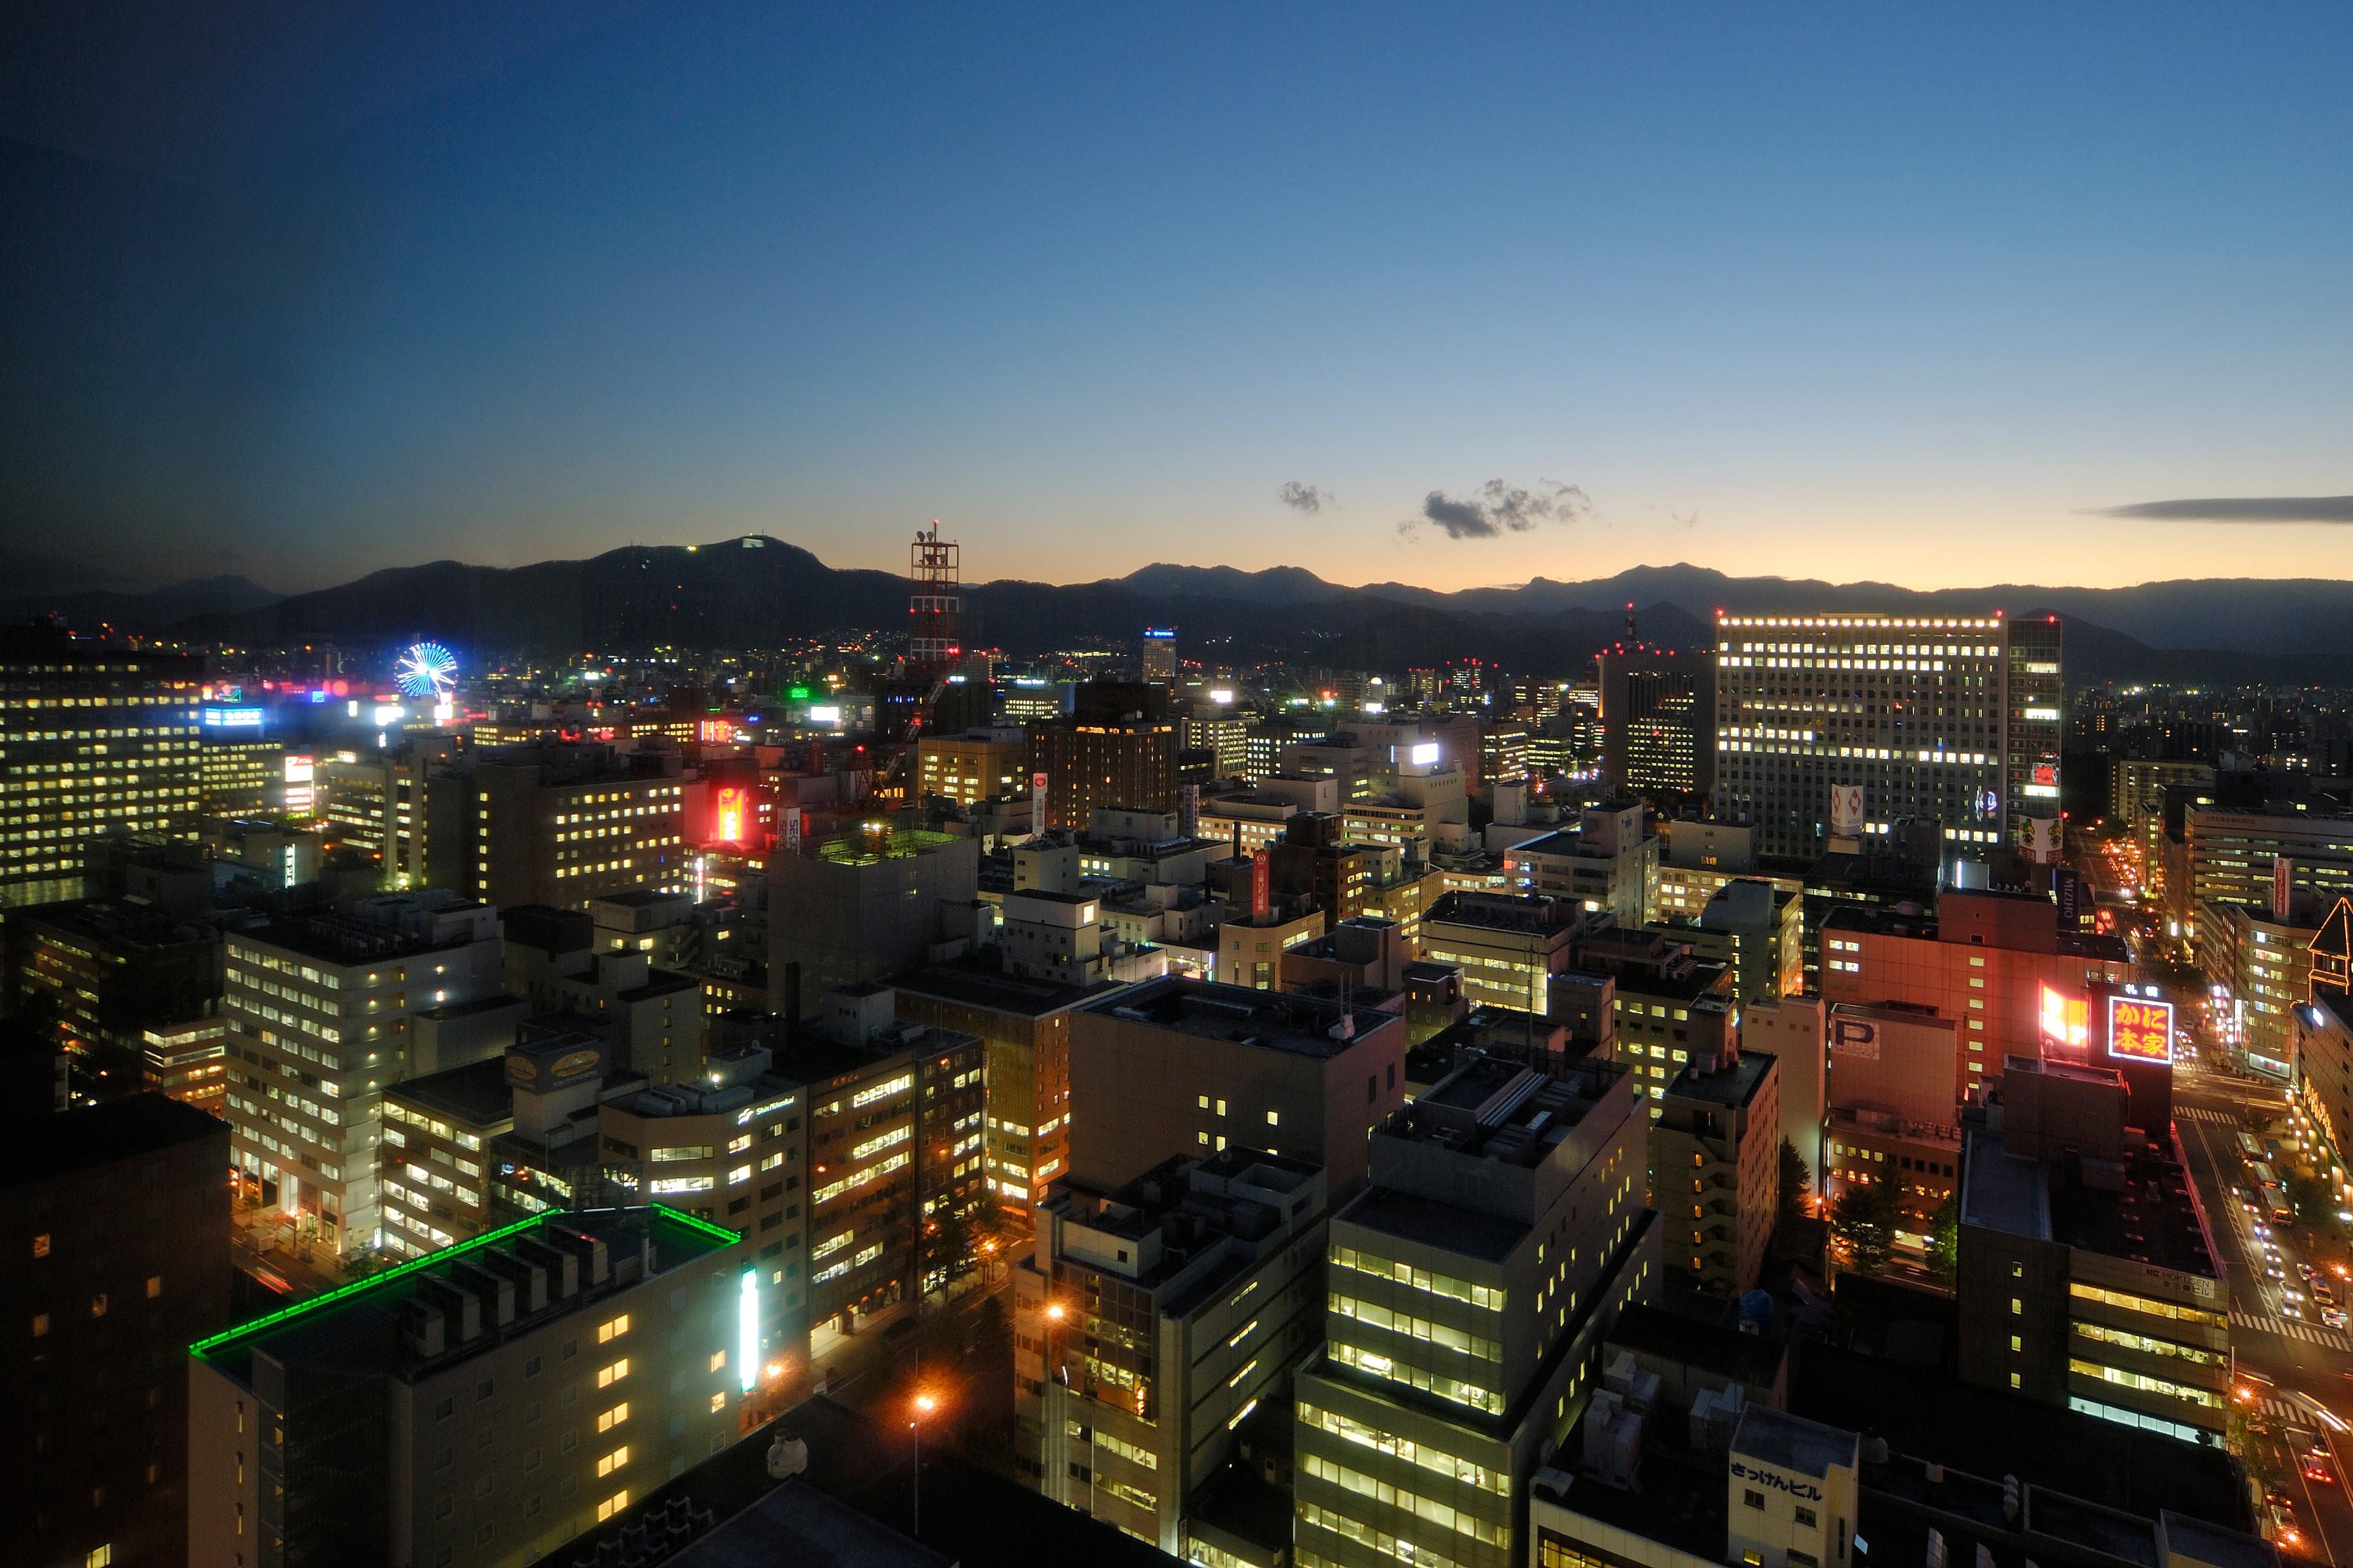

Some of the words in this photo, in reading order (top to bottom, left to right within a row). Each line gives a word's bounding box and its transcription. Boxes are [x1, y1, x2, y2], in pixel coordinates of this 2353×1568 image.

[2064, 877, 2075, 919] MIZUHO
[2115, 1002, 2168, 1031] かに
[1835, 1020, 1875, 1046] P
[2113, 1027, 2168, 1056] 本家
[2161, 1272, 2210, 1288] HOKUSEN
